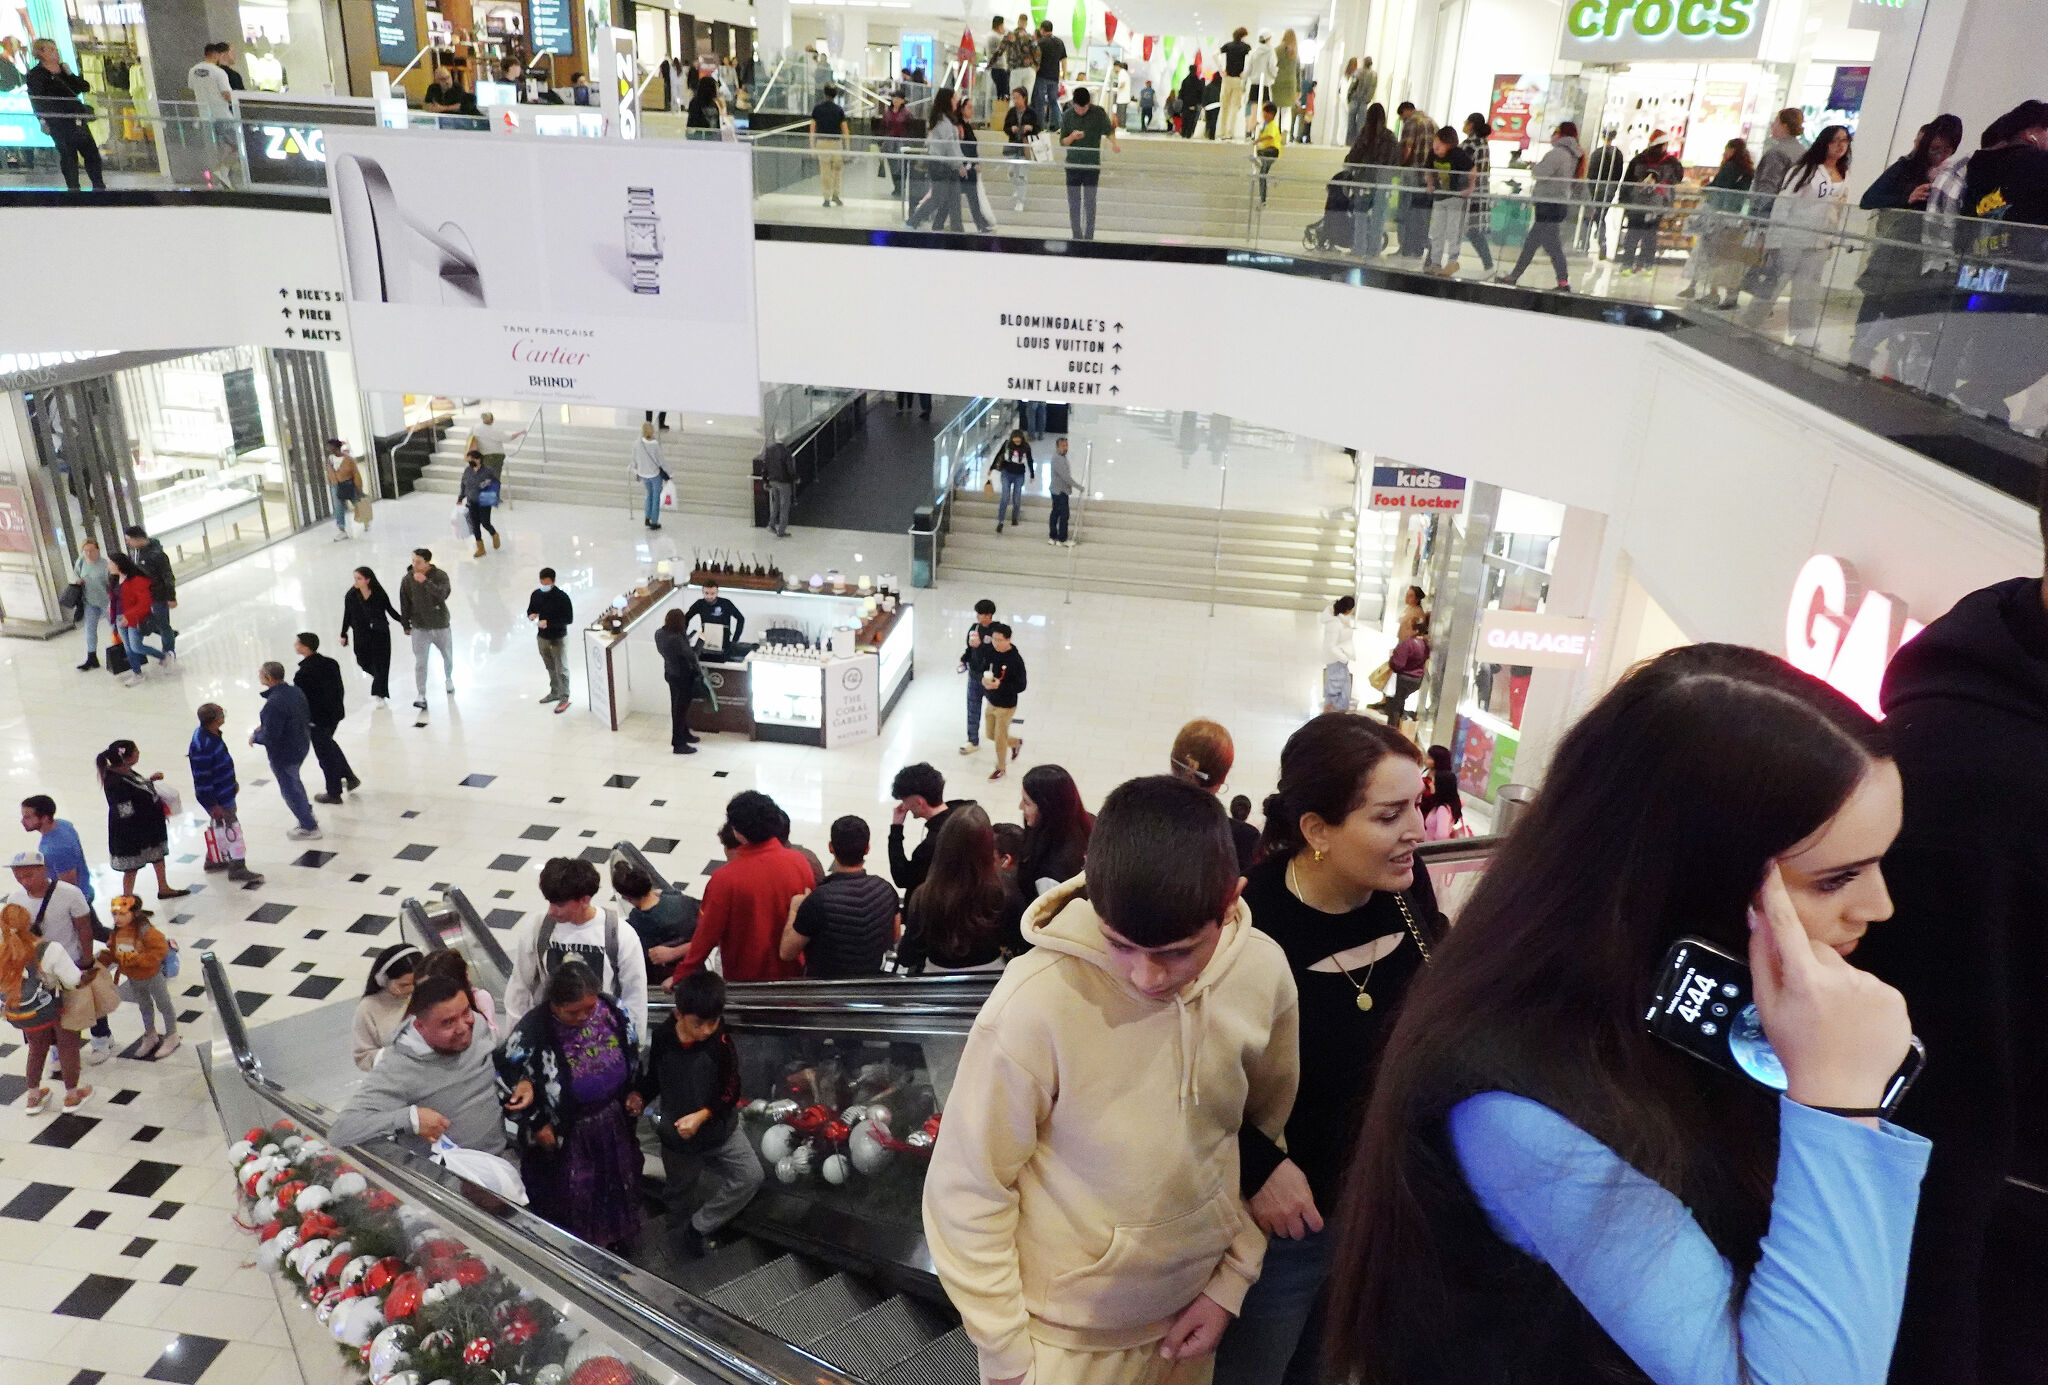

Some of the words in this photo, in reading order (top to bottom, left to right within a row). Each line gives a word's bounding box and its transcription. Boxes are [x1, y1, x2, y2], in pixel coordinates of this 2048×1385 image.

[1567, 0, 1751, 37] crocs
[298, 308, 331, 321] PIRCH
[1000, 313, 1105, 332] BLOOMINGDALE'S
[302, 328, 341, 341] MACY'S
[503, 325, 530, 334] TANK
[512, 338, 591, 365] Cartier
[1016, 336, 1050, 350] LOUIS
[1055, 338, 1105, 353] VUITTON
[1068, 360, 1104, 374] GUCCI
[529, 375, 574, 388] BHINDI
[1007, 377, 1042, 391] SAINT
[1046, 380, 1102, 395] LAURENT
[1397, 470, 1442, 488] kids
[1374, 493, 1406, 507] Foot
[1411, 495, 1460, 509] Locker
[1487, 628, 1586, 655] GARAGE
[1678, 974, 1718, 1023] 4:44
